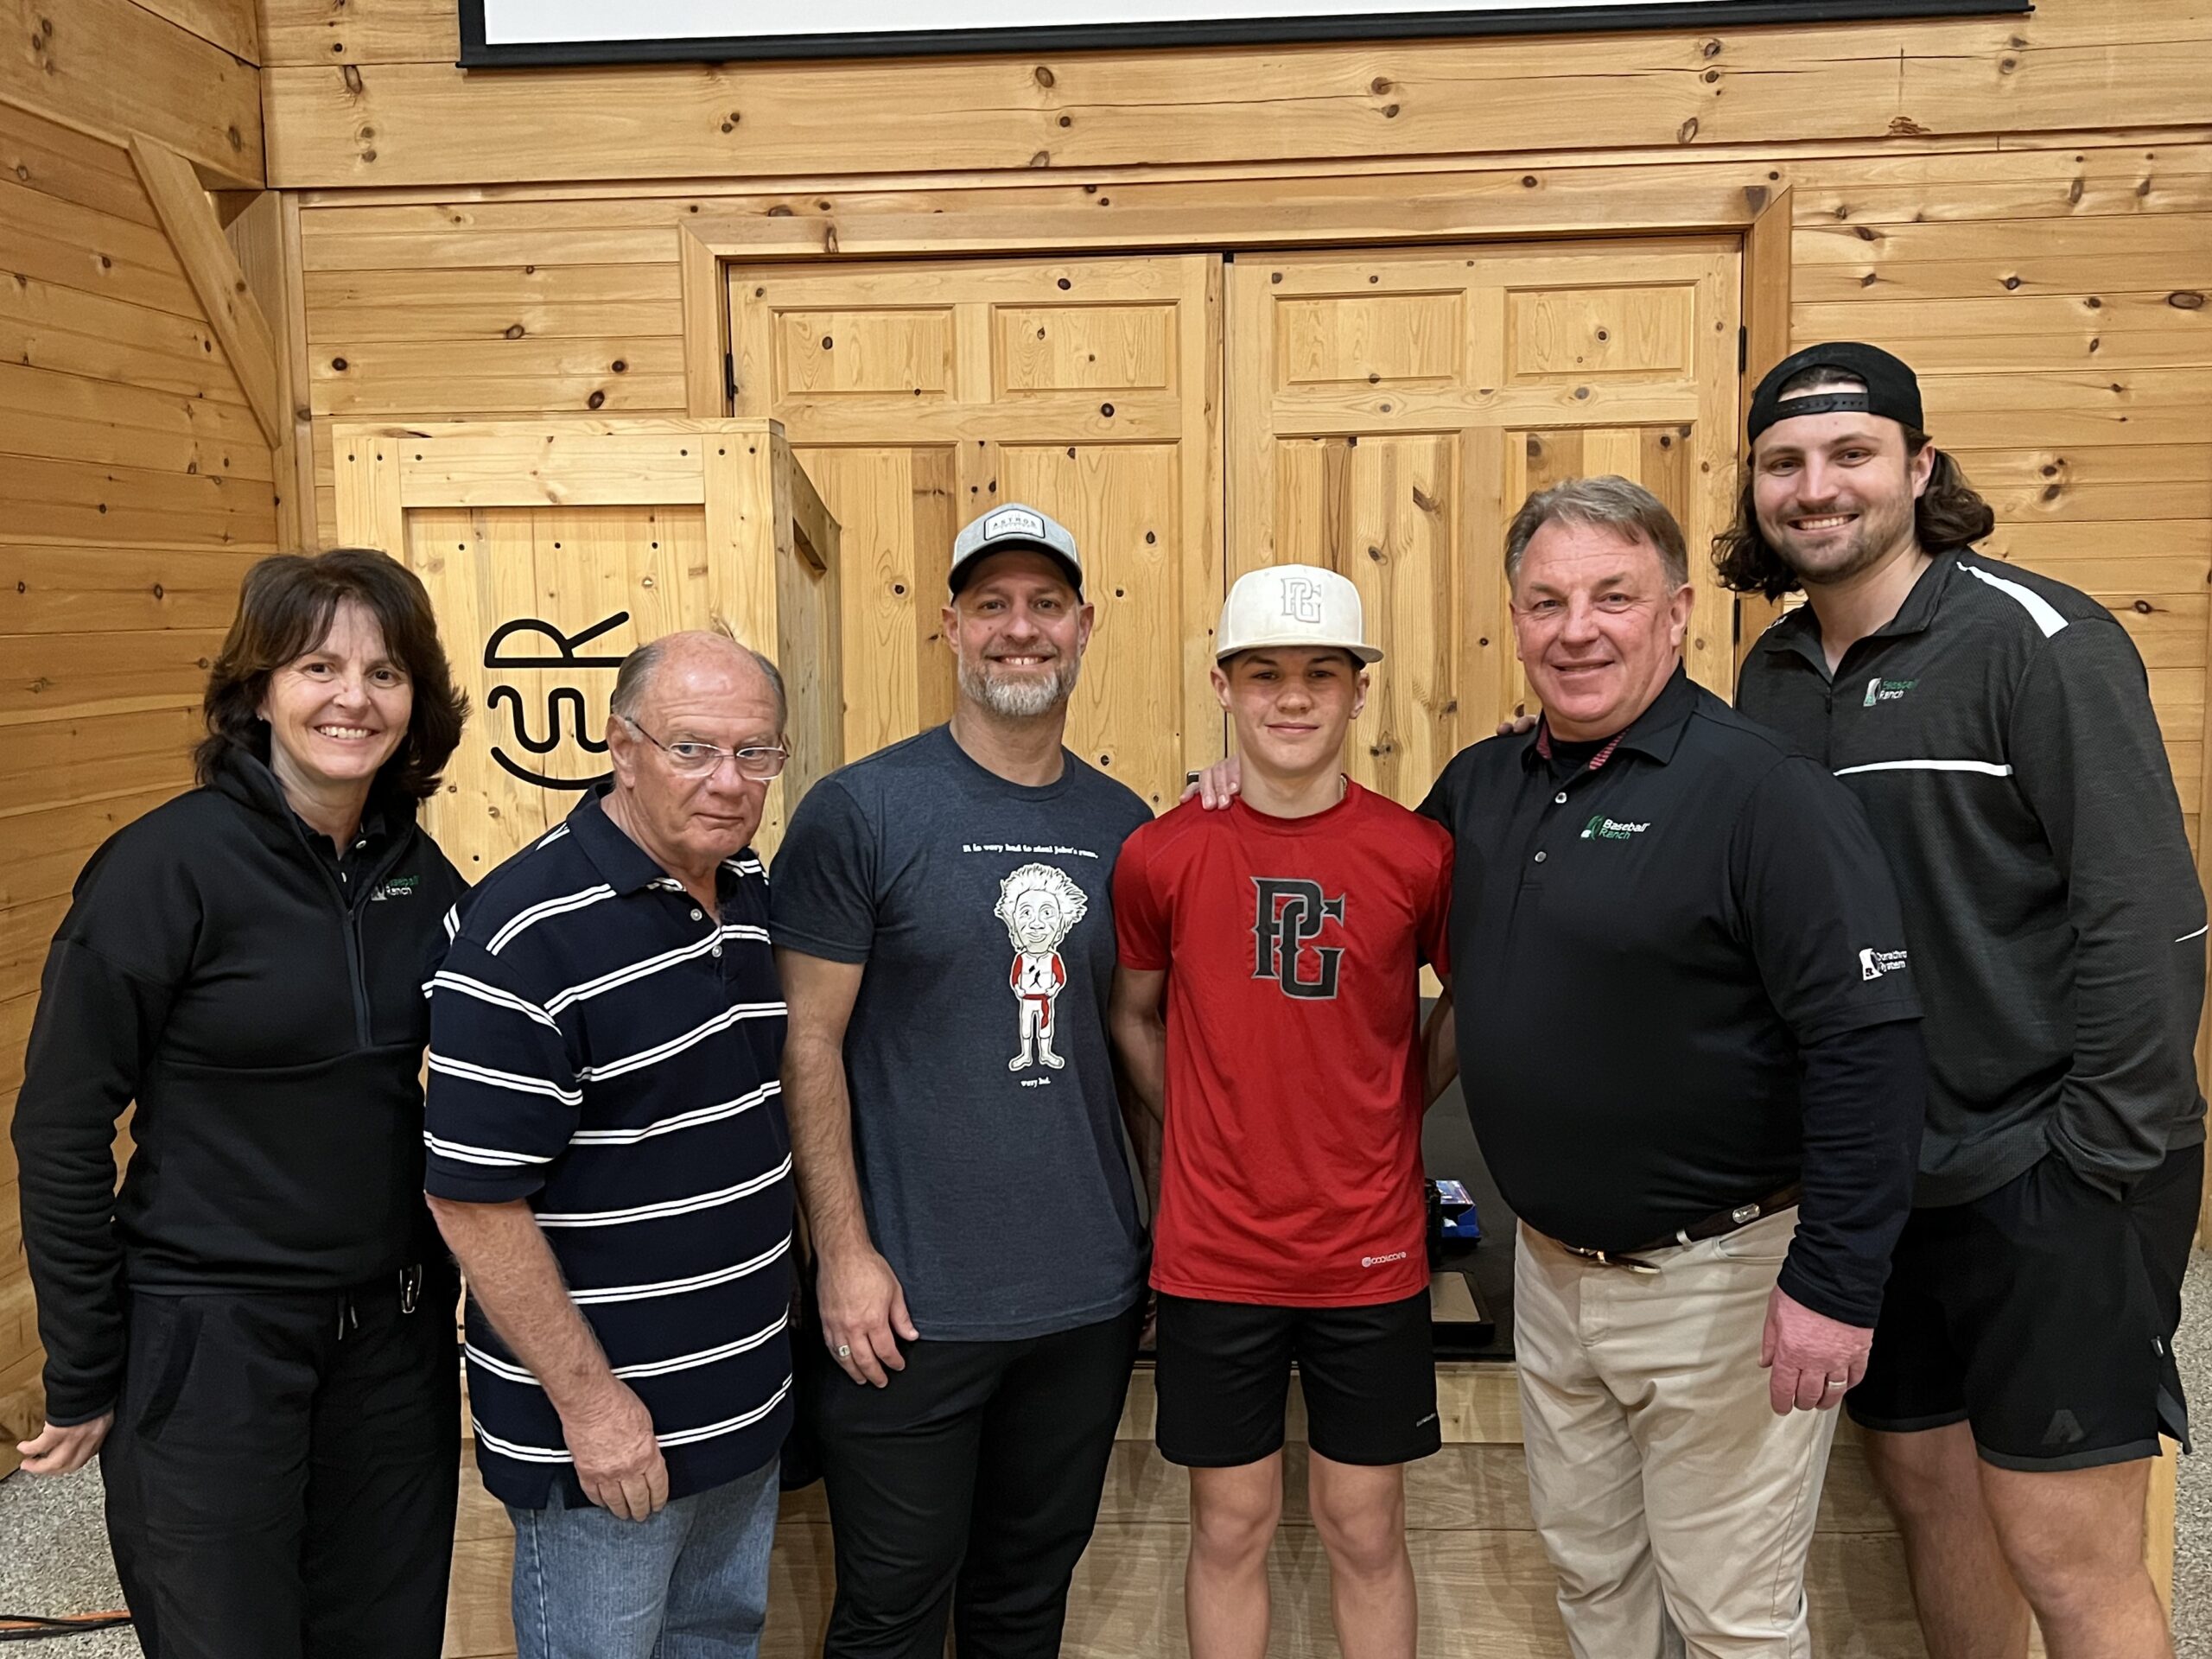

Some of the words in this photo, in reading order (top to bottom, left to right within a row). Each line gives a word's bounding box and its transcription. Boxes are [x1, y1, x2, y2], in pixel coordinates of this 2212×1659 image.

[1878, 690, 1904, 700] Ranch
[1602, 818, 1650, 833] Baseball
[1599, 828, 1631, 840] Ranch
[1249, 876, 1346, 1000] PG
